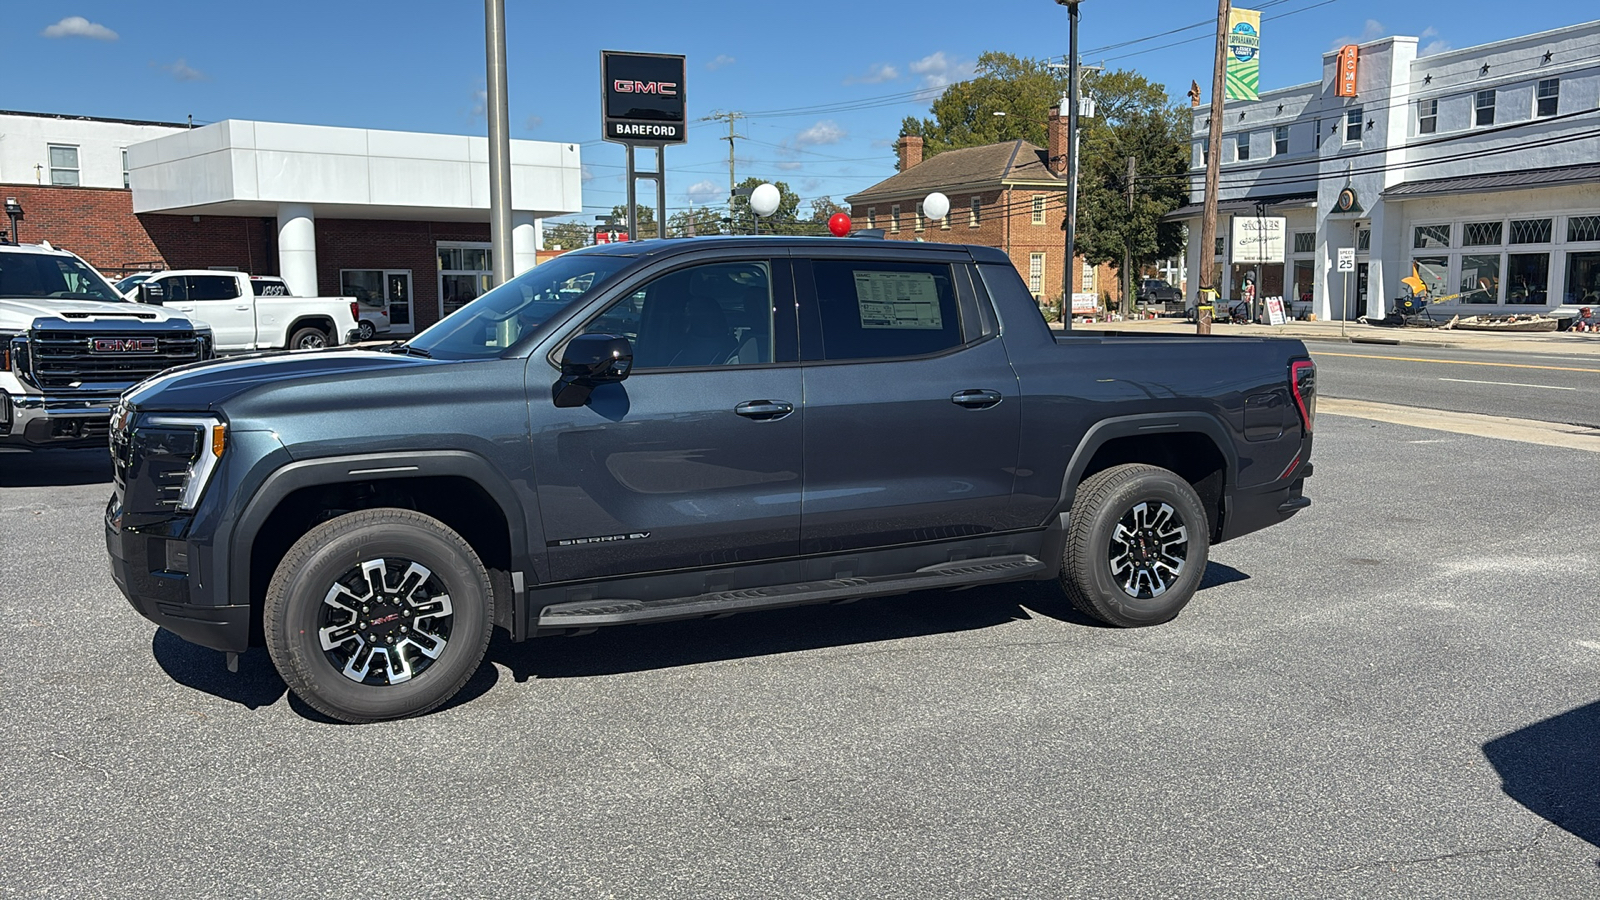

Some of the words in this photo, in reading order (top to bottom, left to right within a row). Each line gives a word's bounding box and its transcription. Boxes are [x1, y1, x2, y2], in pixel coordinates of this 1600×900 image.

[1345, 48, 1355, 93] ACME
[614, 79, 677, 95] GMC
[616, 124, 676, 136] BAREFORD
[1339, 259, 1353, 269] 25
[95, 339, 155, 351] GMC
[559, 535, 625, 546] SIERRA
[371, 613, 399, 626] GMC
